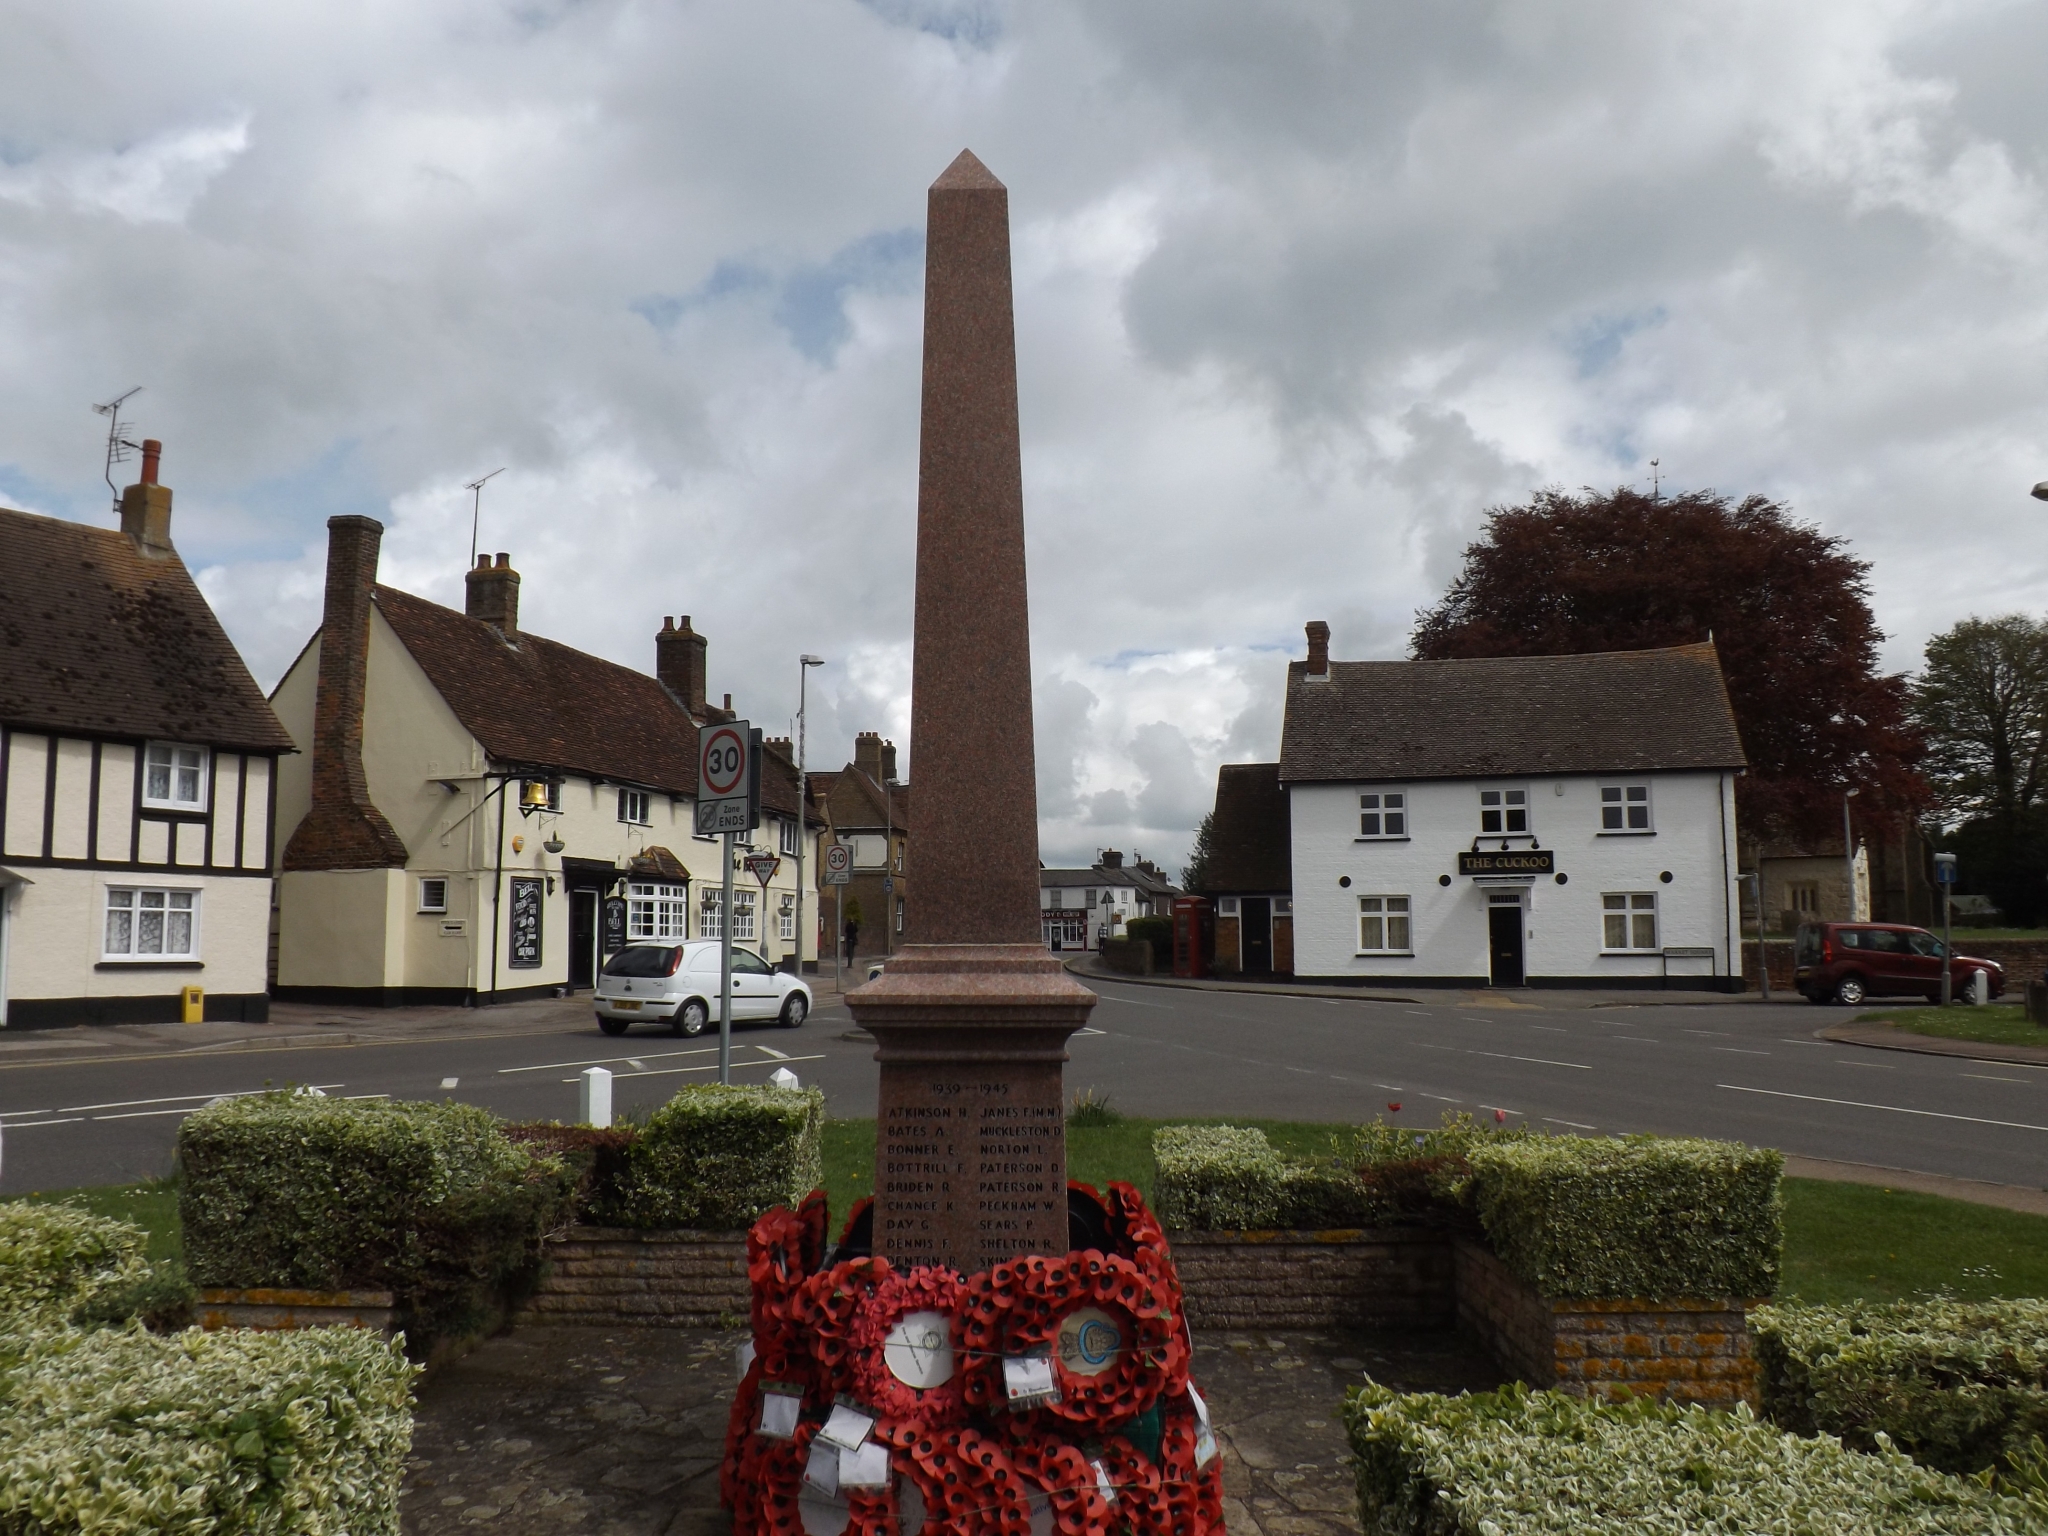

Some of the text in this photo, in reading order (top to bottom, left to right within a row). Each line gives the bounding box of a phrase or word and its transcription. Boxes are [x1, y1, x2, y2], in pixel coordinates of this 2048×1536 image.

[709, 746, 739, 775] 30
[723, 805, 740, 814] Zone
[719, 815, 745, 827] ENDS
[831, 853, 845, 863] 30
[1464, 856, 1549, 868] THE CUCKOO
[932, 1083, 961, 1094] 1939
[980, 1083, 1008, 1095] 1945
[889, 1107, 951, 1118] ATKINSON
[980, 1108, 1018, 1118] JANES
[888, 1125, 926, 1137] BATES
[980, 1126, 1049, 1137] MUCKLESTON
[887, 1144, 939, 1155] BONNER
[980, 1144, 1029, 1155] NORTON
[887, 1163, 948, 1174] BOTTRILL
[980, 1163, 1043, 1174] PATERSON
[887, 1182, 934, 1193] BRIDEN
[980, 1182, 1043, 1193] PATERSON
[887, 1201, 938, 1211] CHANCE
[980, 1201, 1036, 1212] PECKHAM
[887, 1219, 914, 1230] DAY
[980, 1220, 1018, 1230] SEARS
[887, 1238, 933, 1249] DENNIS
[980, 1239, 1036, 1249] SHELTON
